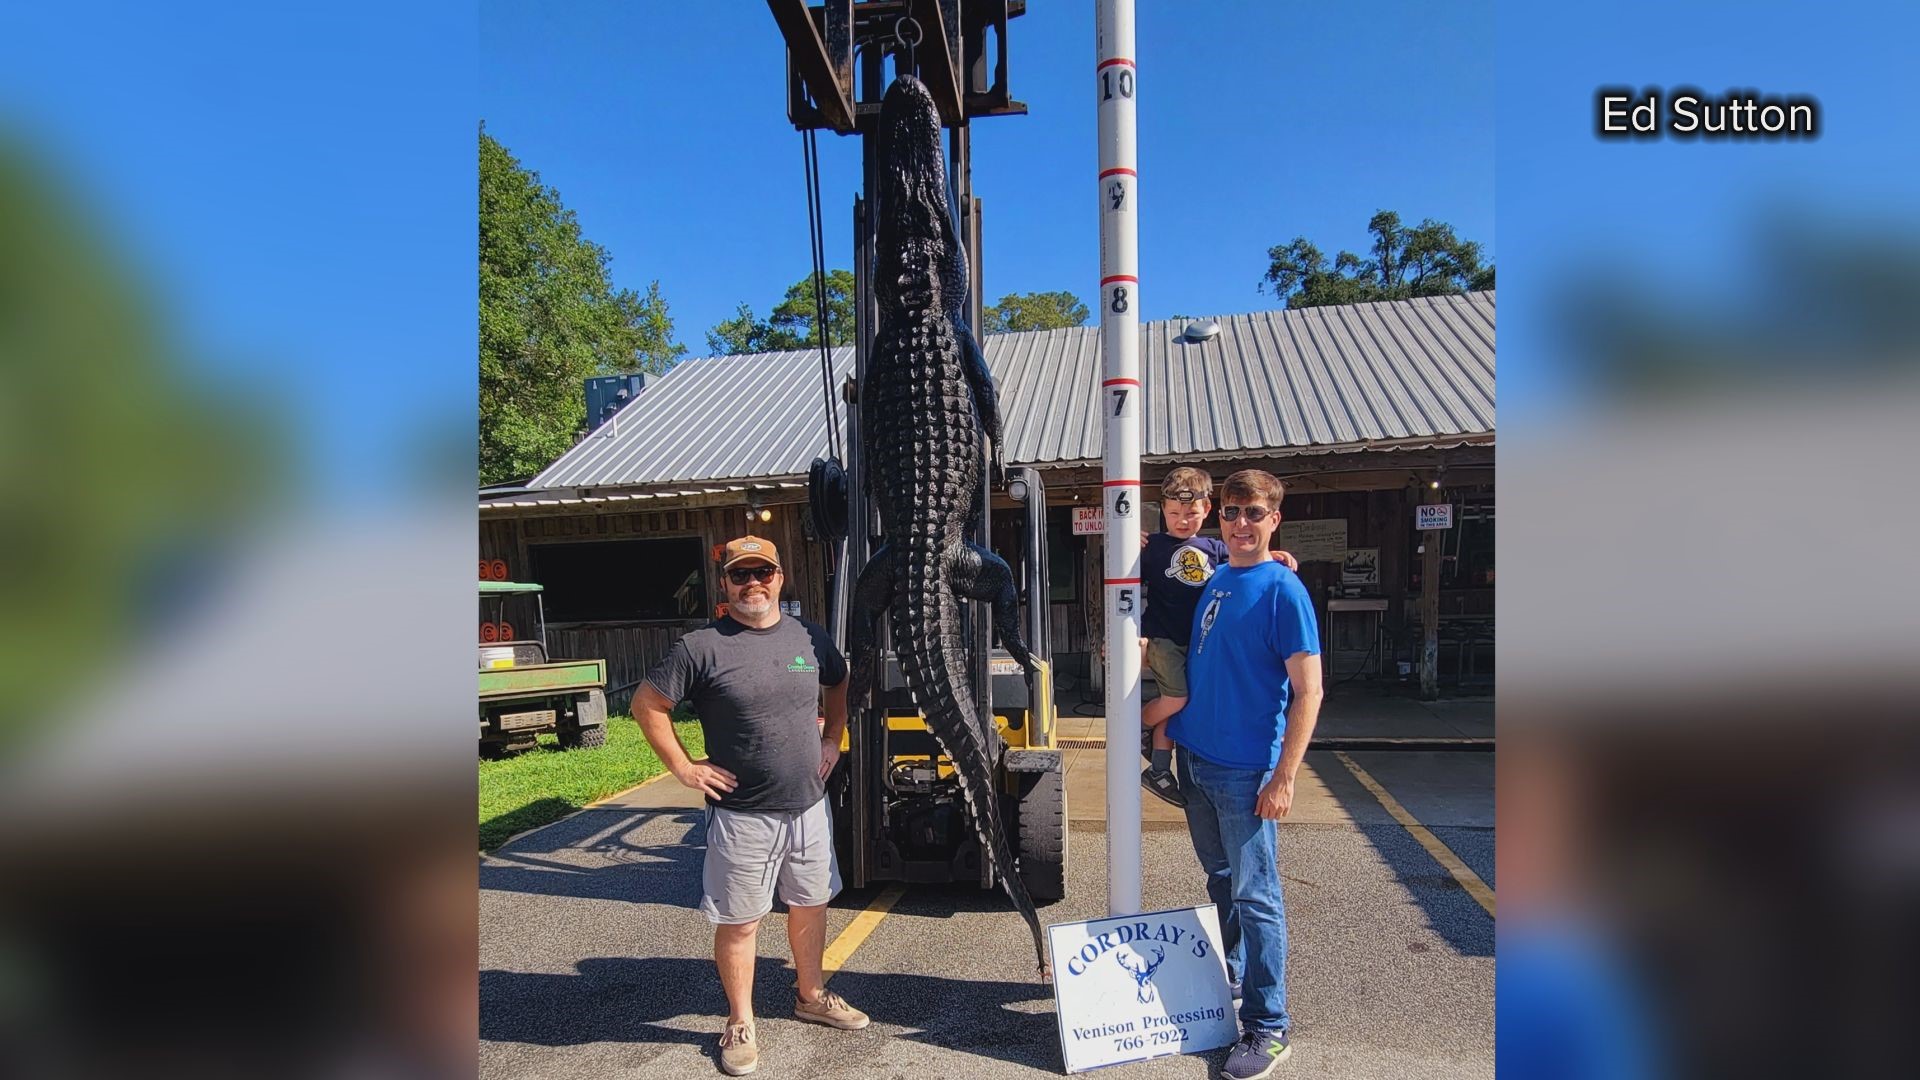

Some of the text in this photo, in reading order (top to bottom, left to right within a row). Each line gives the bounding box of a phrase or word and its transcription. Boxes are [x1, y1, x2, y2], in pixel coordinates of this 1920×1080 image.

[1102, 69, 1134, 101] 10
[1108, 181, 1126, 210] 9
[1112, 286, 1128, 313] 8
[1113, 390, 1129, 416] 7
[1079, 510, 1097, 520] BACK
[1114, 490, 1131, 516] 6
[1421, 508, 1436, 516] NO
[1074, 521, 1083, 531] TO
[1118, 589, 1134, 615] 5
[1067, 922, 1210, 977] CORDRAY'S
[1072, 1006, 1225, 1042] Venison Processing
[1113, 1027, 1189, 1053] 766-7922
